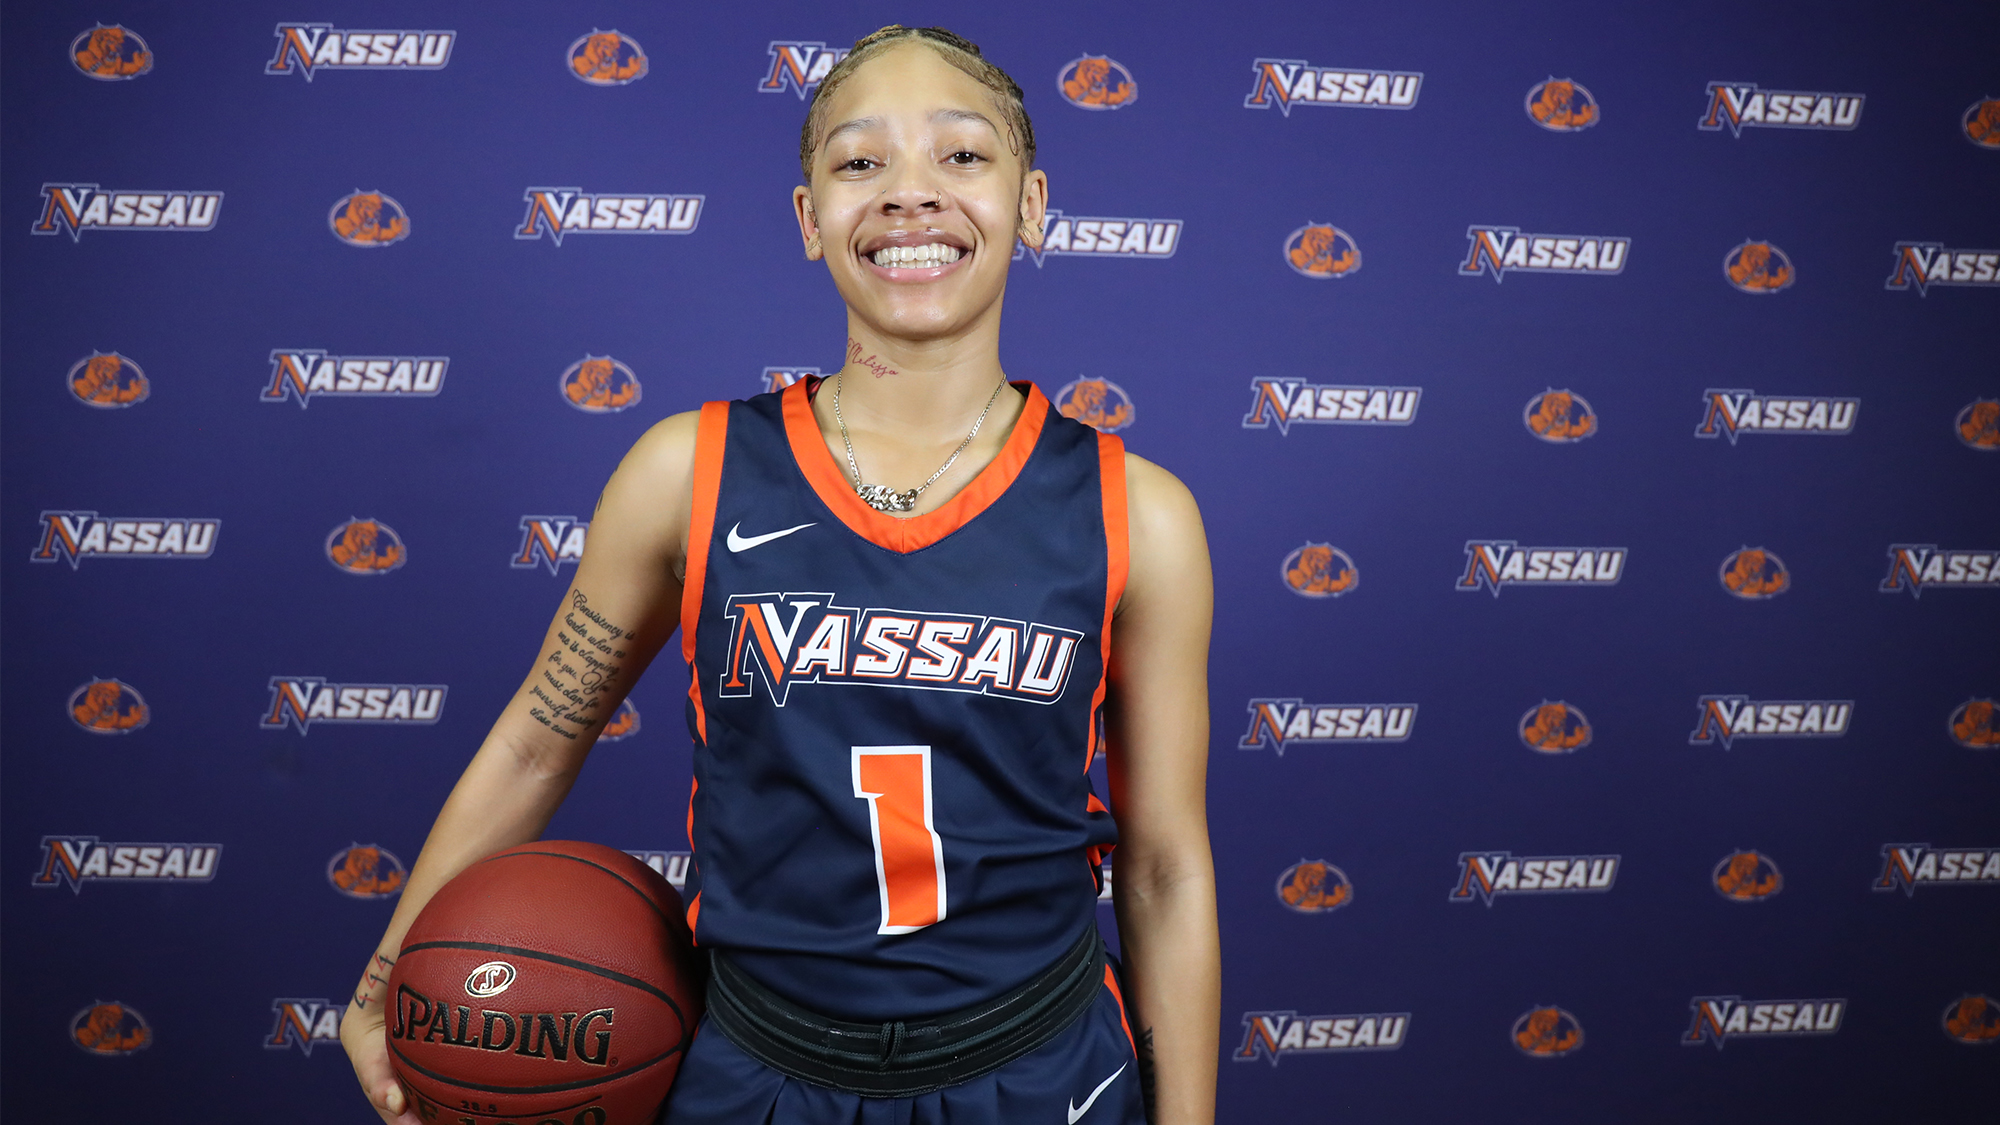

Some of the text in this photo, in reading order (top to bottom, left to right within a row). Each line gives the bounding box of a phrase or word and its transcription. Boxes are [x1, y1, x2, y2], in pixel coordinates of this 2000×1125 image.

[270, 26, 454, 75] NASSAU
[1249, 61, 1420, 111] NASSAU
[1702, 84, 1862, 132] NASSAU
[38, 186, 222, 236] NASSAU
[520, 190, 702, 240] NASSAU
[1464, 228, 1628, 276] NASSAU
[1890, 244, 2000, 290] NASS
[266, 352, 447, 402] NASSAU
[845, 337, 899, 379] Melissa
[1248, 380, 1419, 429] NASSAU
[1700, 391, 1857, 438] NASSAU
[36, 514, 218, 563] NASSAU
[1460, 543, 1624, 590] NASSAU
[565, 612, 626, 659] harder when no
[573, 589, 636, 641] Consistency is
[557, 631, 619, 678] one is clapping
[722, 597, 1080, 701] NASSAU
[266, 679, 445, 728] NASSAU
[544, 670, 599, 711] must clap for
[581, 671, 616, 695] You
[529, 685, 598, 730] yourself during
[1244, 701, 1415, 750] NASSAU
[1694, 698, 1851, 744] NASSAU
[551, 725, 577, 739] times
[40, 839, 220, 888] NASSAU
[851, 746, 946, 935] 1
[1454, 854, 1618, 901] NASSAU
[1238, 1014, 1407, 1060] NASSAU
[1686, 998, 1843, 1046] NASSAU
[461, 1100, 499, 1114] 28.5
